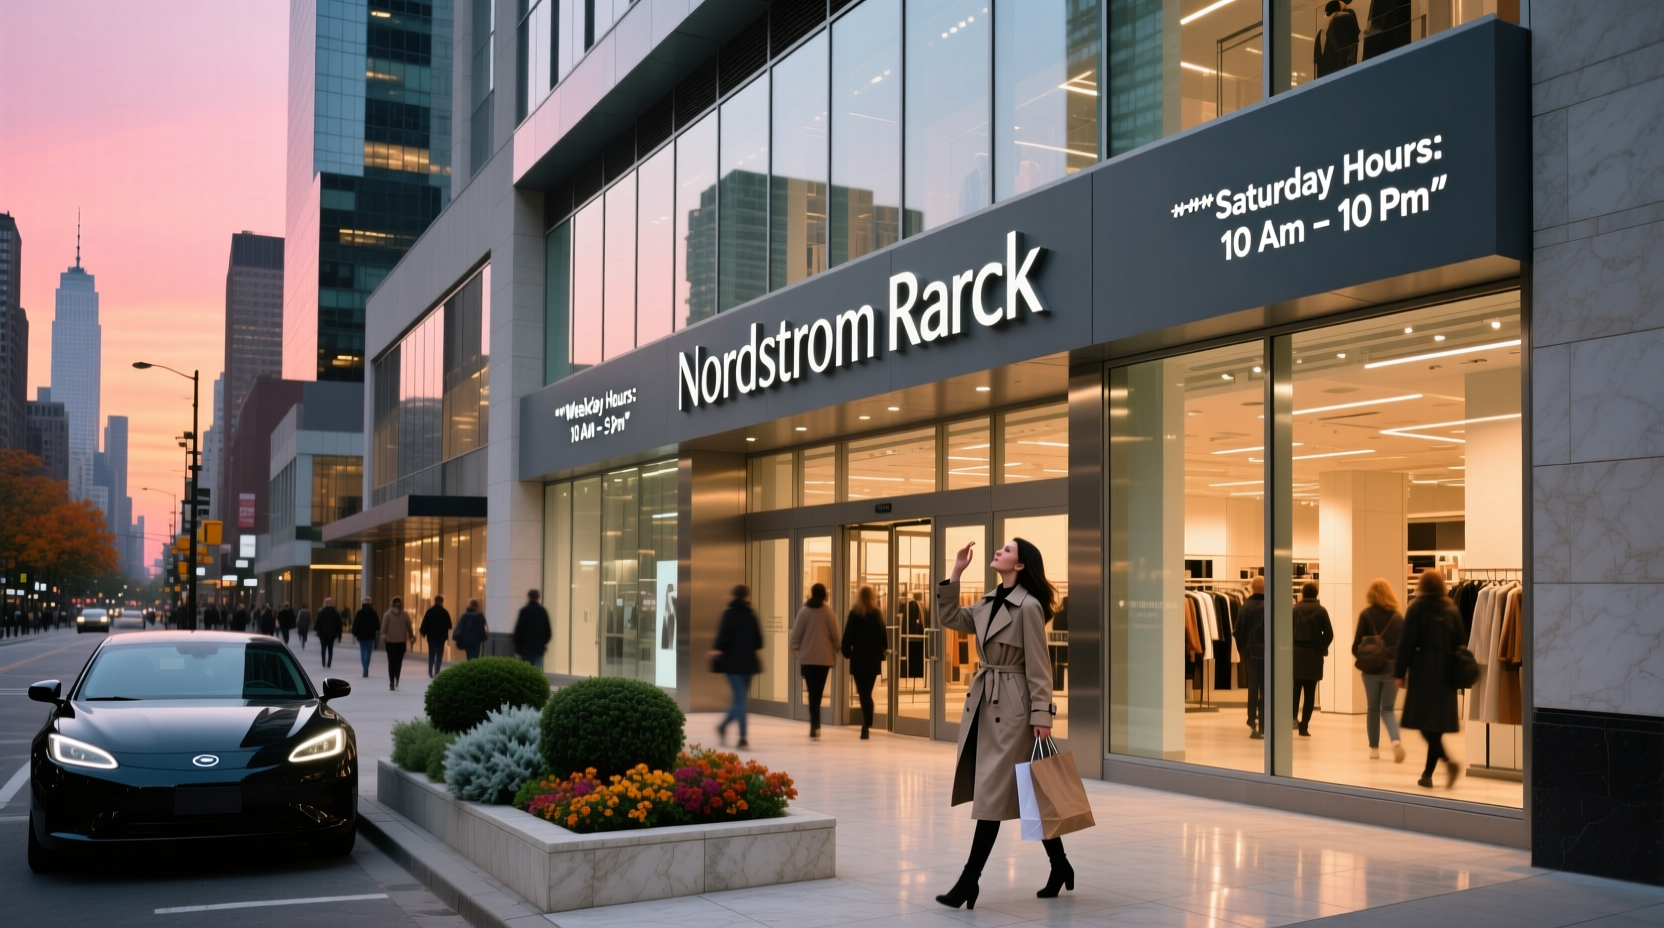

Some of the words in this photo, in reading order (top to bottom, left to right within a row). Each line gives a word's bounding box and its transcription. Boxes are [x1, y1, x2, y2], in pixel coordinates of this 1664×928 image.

[1343, 134, 1442, 185] Hours:
[1220, 226, 1252, 261] 10
[1257, 219, 1305, 253] Am
[1337, 193, 1373, 232] 10
[678, 305, 878, 411] Nordstrom
[888, 230, 1052, 352] Rarck
[605, 387, 637, 409] Hours:
[570, 424, 580, 444] 10
